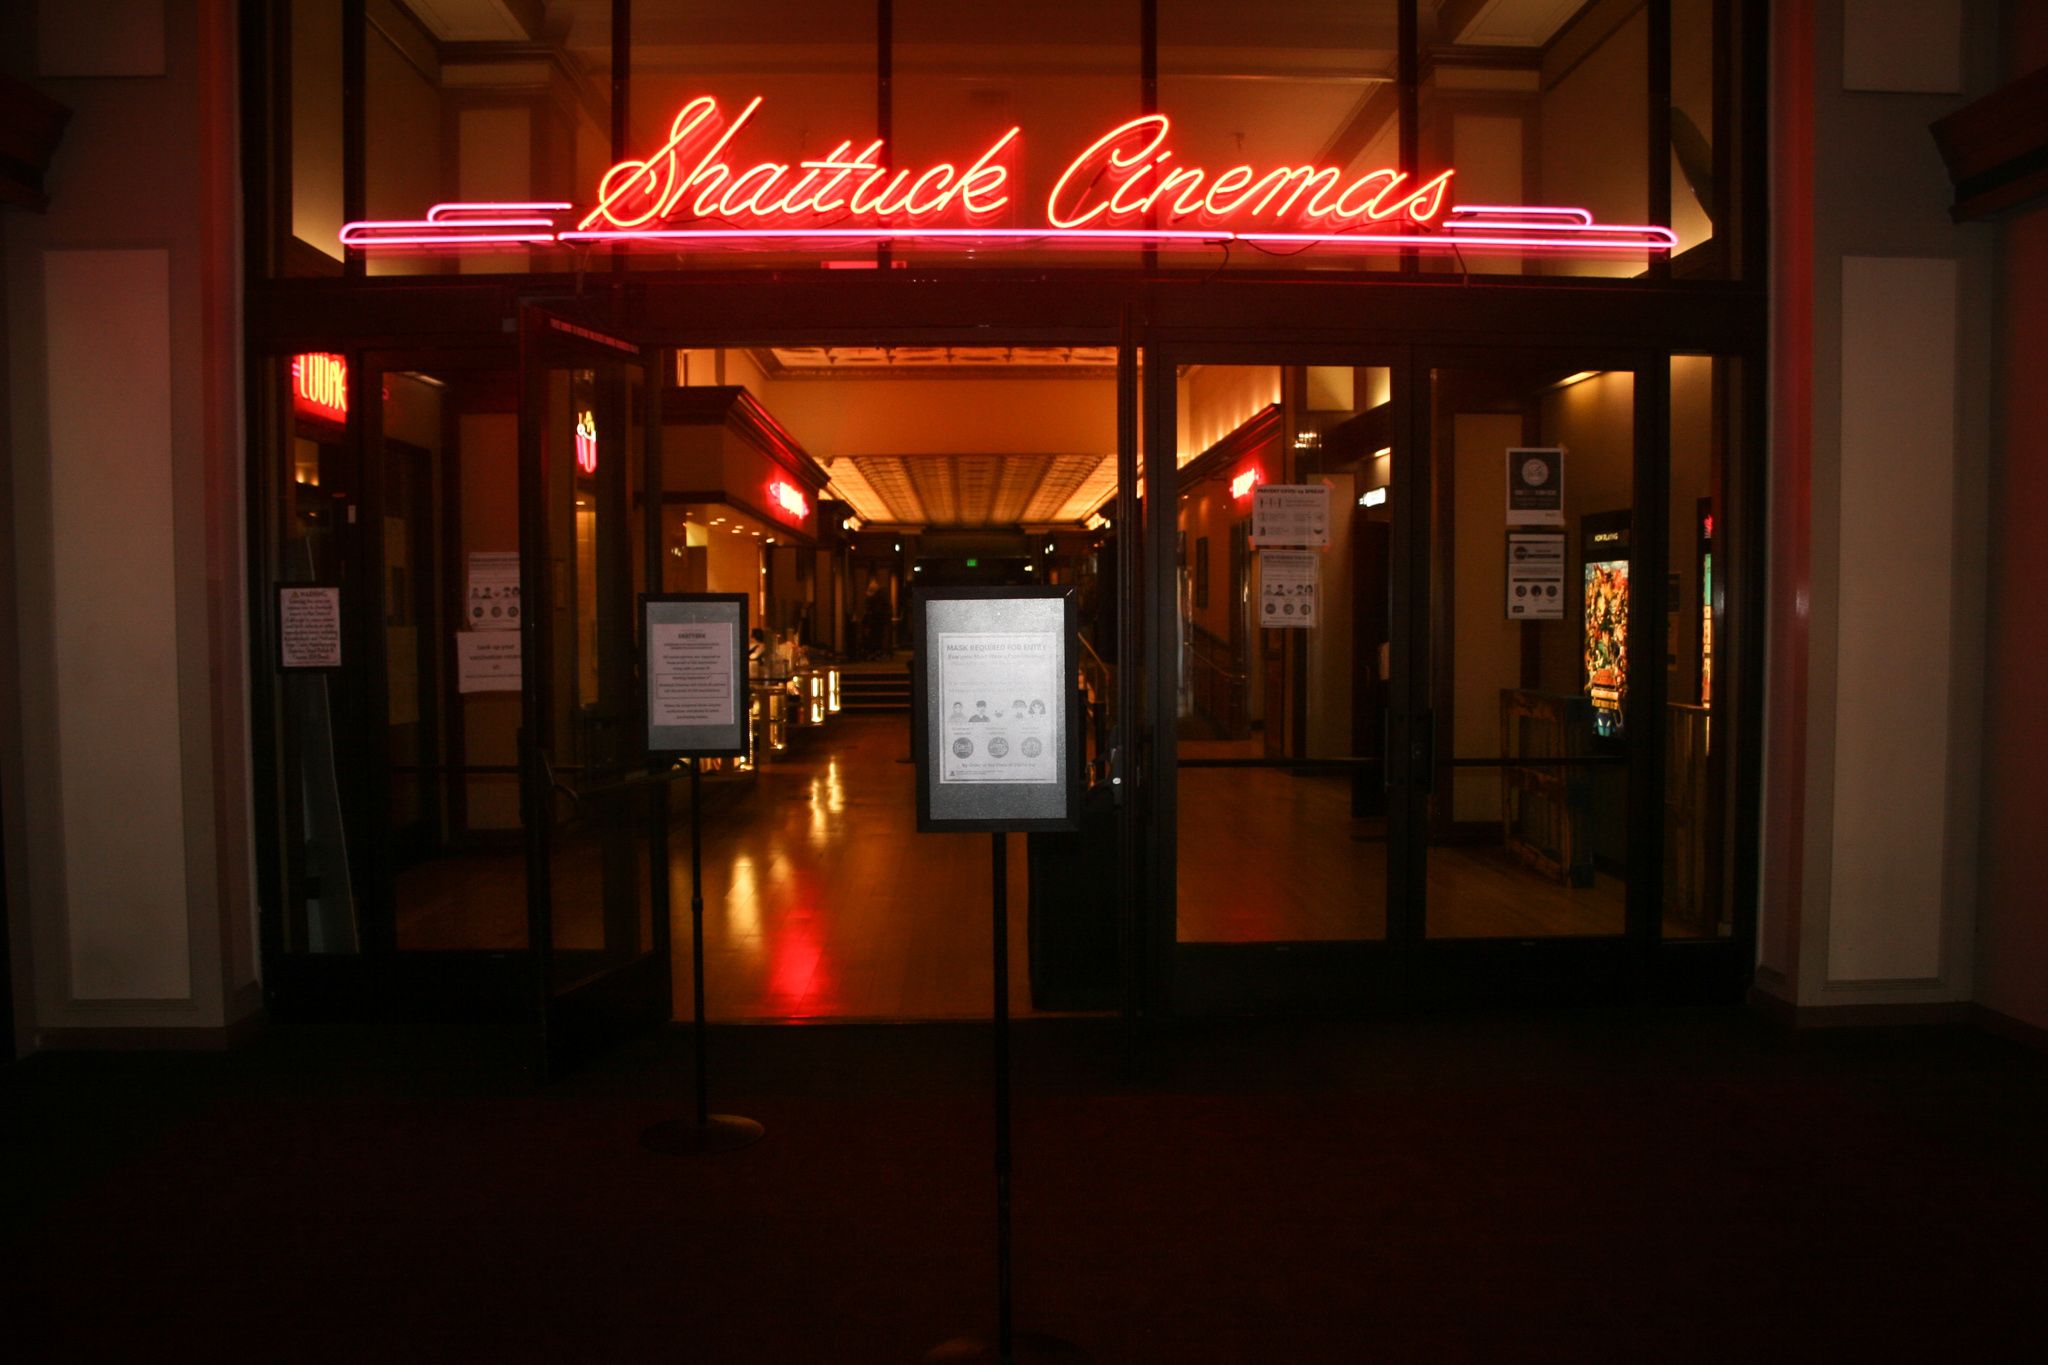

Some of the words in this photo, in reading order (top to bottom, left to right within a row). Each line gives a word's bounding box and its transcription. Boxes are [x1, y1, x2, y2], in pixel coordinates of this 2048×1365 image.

[578, 95, 1020, 230] Shattuck
[1047, 112, 1456, 229] Cinemas
[946, 644, 968, 652] MASK
[970, 644, 1005, 652] REQUIRED
[1007, 644, 1021, 652] FOR
